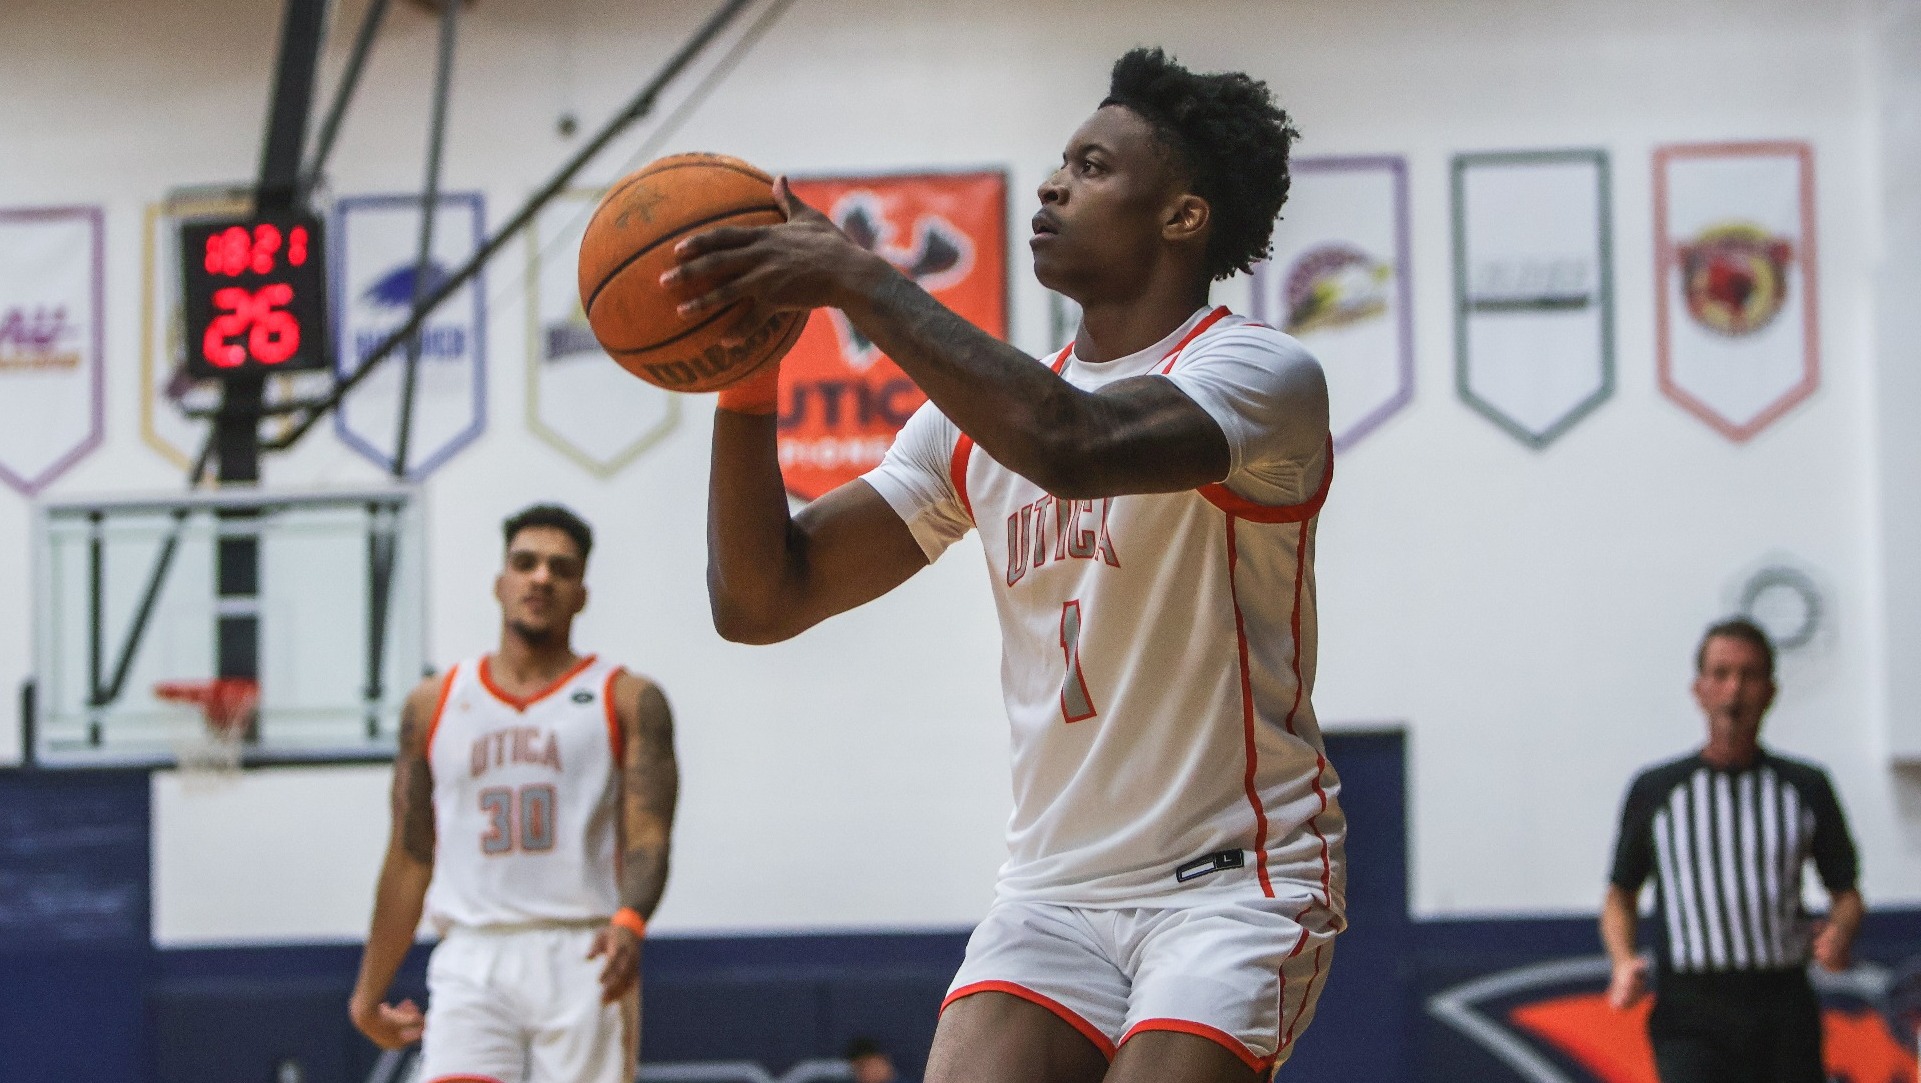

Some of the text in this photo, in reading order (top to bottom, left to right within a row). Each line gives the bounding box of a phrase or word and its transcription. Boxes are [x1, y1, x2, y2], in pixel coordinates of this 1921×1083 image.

[203, 282, 300, 368] 26
[778, 377, 918, 428] UTIC
[1007, 493, 1121, 587] UTICA
[1060, 599, 1097, 724] 1
[469, 725, 564, 779] UTICA
[478, 782, 558, 857] 30
